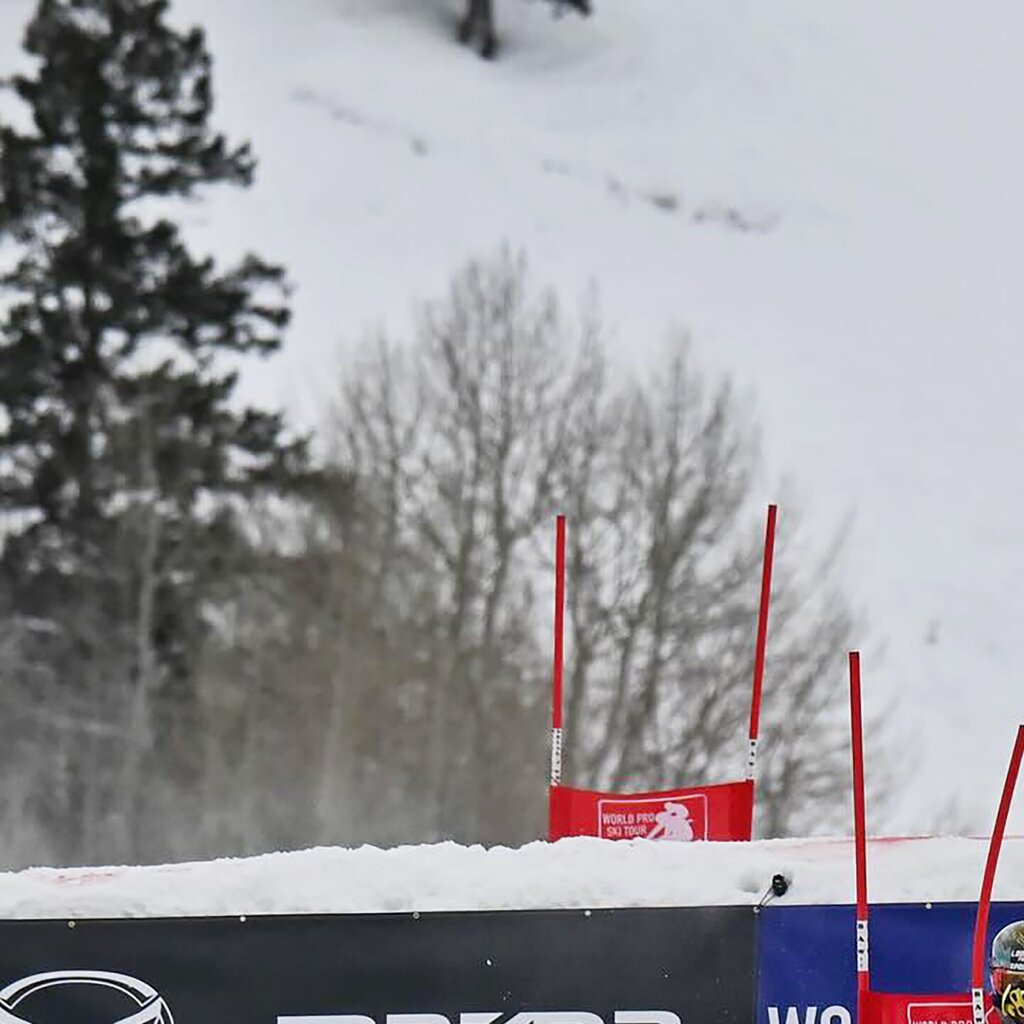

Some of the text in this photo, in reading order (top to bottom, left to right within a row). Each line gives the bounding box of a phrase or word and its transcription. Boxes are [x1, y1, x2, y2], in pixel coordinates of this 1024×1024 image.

[603, 813, 634, 825] WORLD
[607, 825, 647, 836] SKI TOUR
